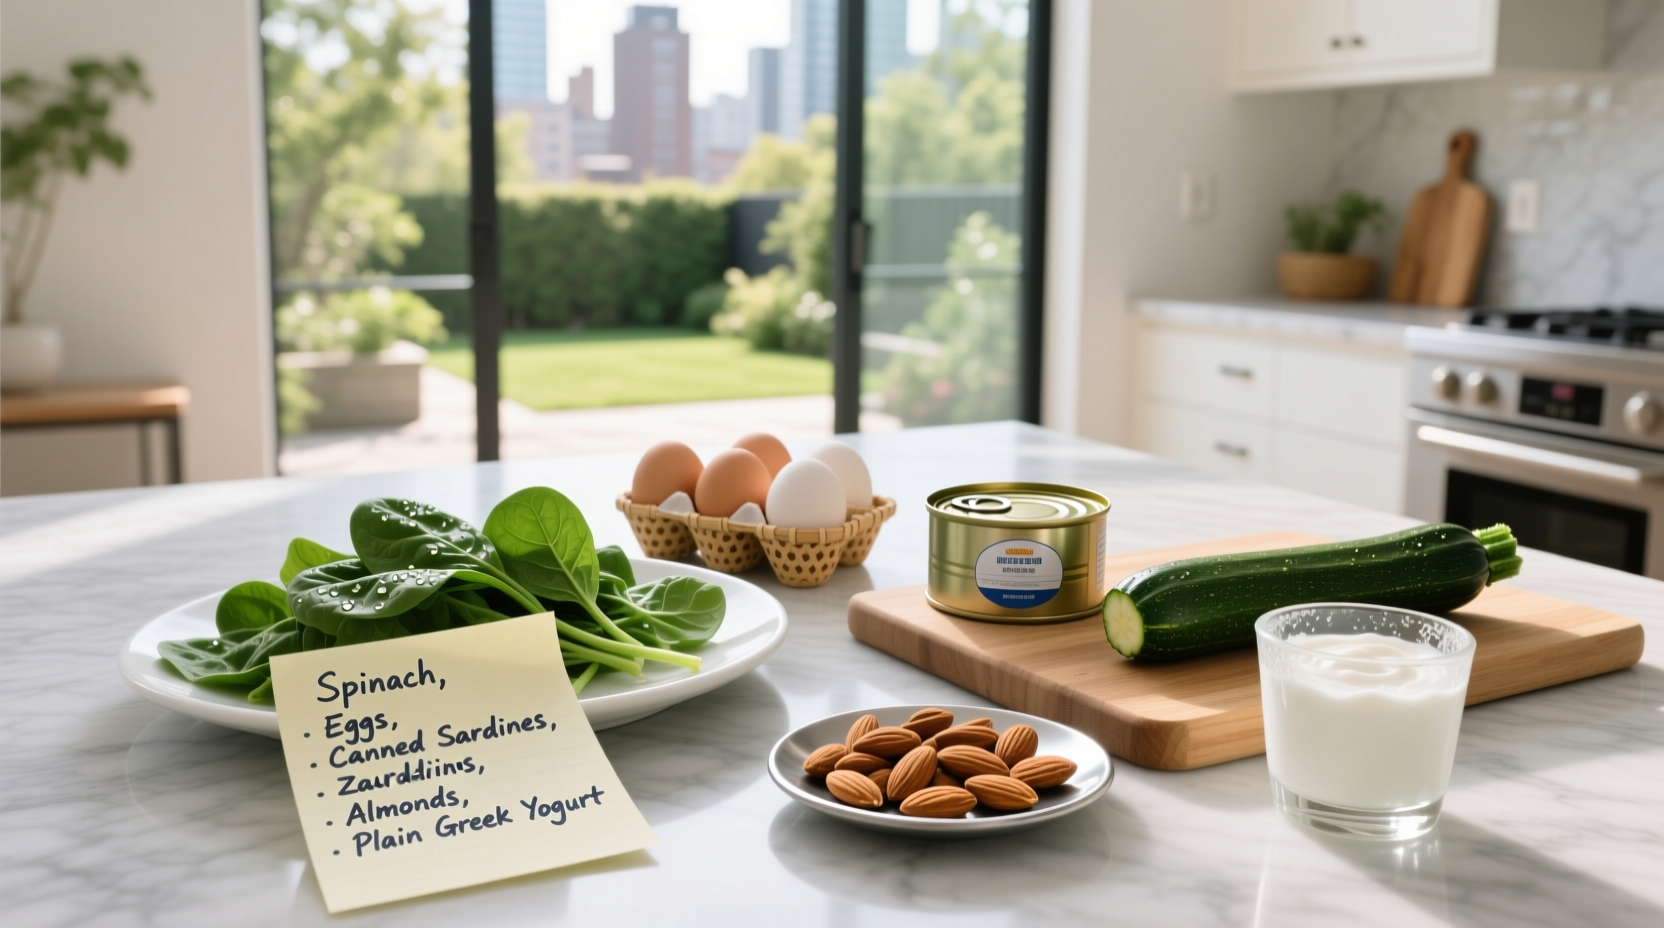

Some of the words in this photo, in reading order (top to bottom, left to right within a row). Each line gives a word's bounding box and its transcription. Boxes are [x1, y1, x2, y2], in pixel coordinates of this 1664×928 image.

[316, 657, 446, 709] Spinach,
[324, 712, 398, 746] Eggs,
[328, 728, 426, 769] Canned
[437, 713, 557, 748] Sardines,
[345, 785, 469, 827] Almonds,
[352, 827, 424, 857] Plain
[435, 805, 514, 838] Greek
[519, 785, 605, 826] Yogurt
